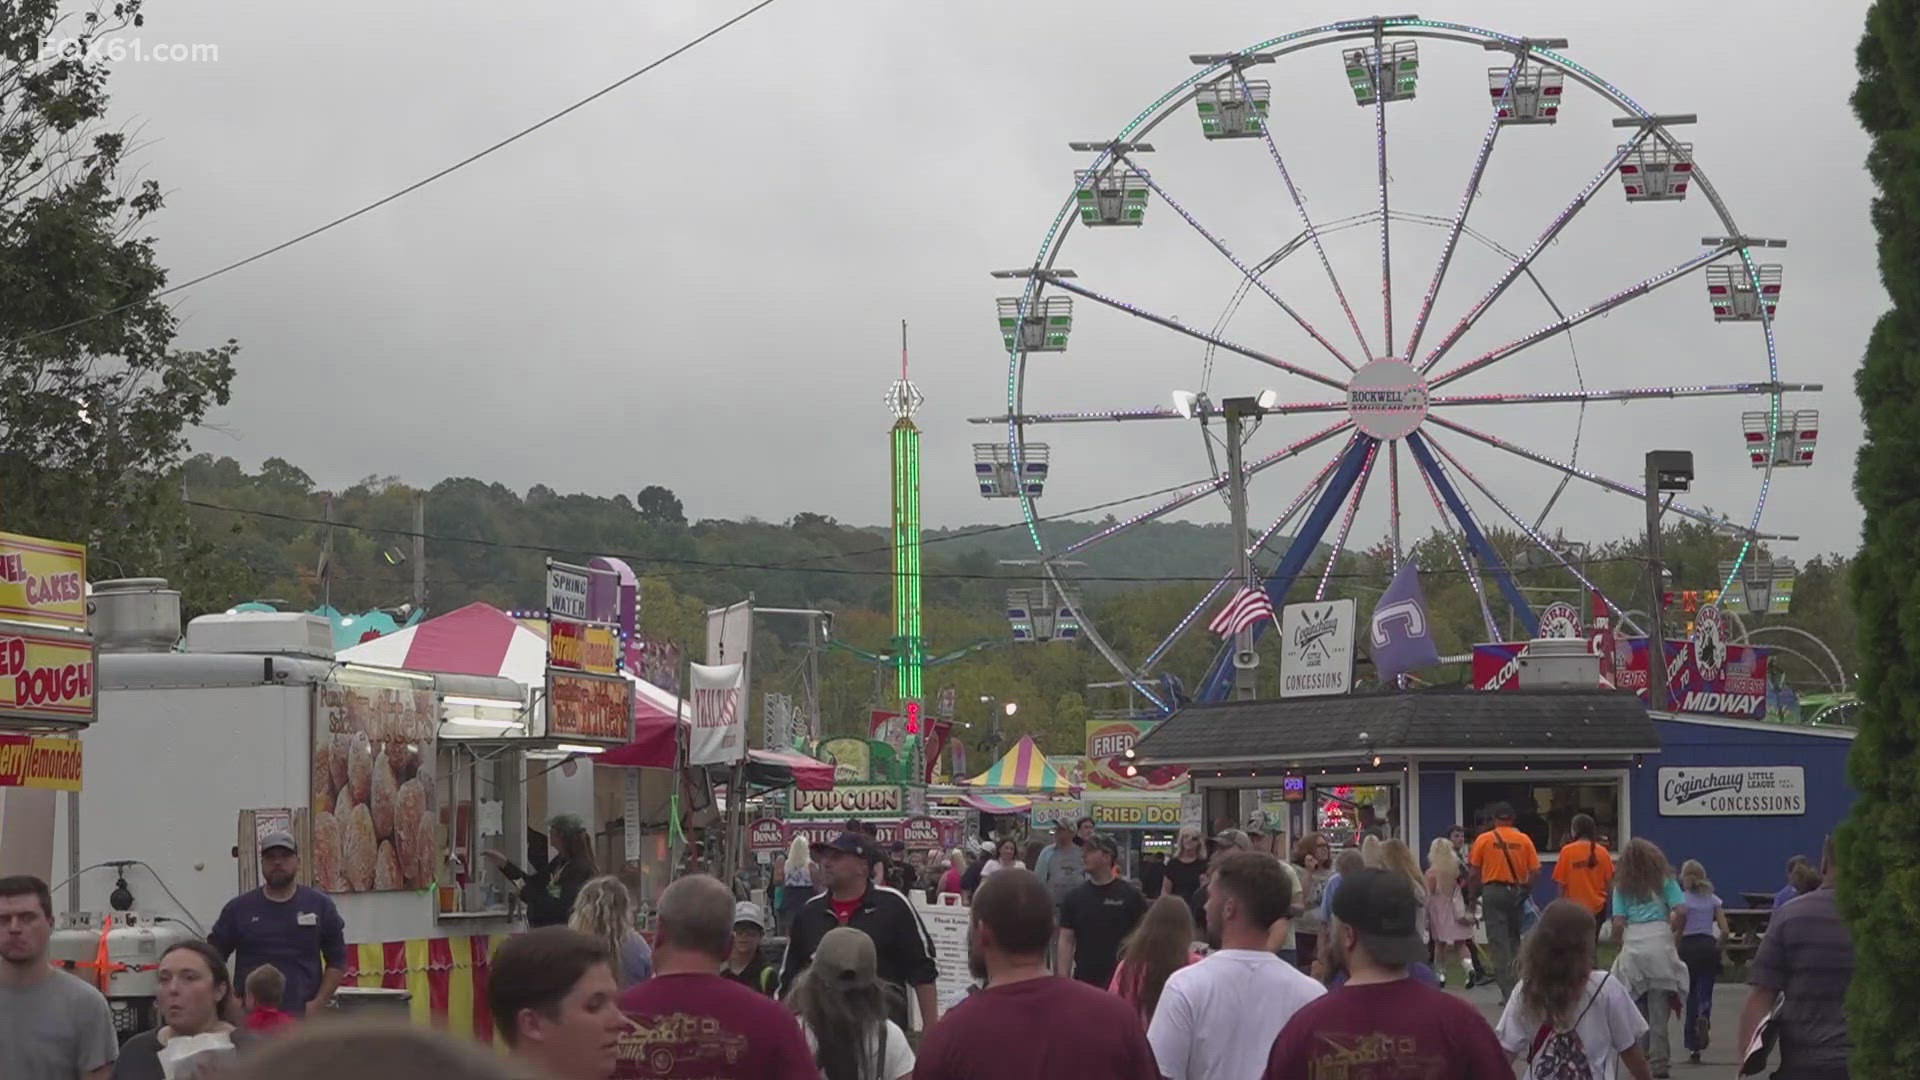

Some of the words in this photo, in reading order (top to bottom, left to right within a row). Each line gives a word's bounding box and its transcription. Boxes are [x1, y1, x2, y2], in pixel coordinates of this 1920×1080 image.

[1351, 391, 1404, 402] ROCKWELL
[26, 572, 81, 605] CAKES
[552, 573, 586, 595] SPRING
[1540, 606, 1583, 638] DURHAM
[1480, 644, 1529, 691] ELCOME
[16, 664, 92, 706] DOUGH
[1286, 671, 1342, 691] CONCESSIONS
[1683, 691, 1764, 714] MIDWAY
[1094, 735, 1135, 756] FRIED
[26, 738, 82, 782] lemonade
[1284, 777, 1303, 790] OPEN
[1747, 772, 1774, 780] LITTLE
[1664, 772, 1743, 803] Coginchaug
[794, 788, 897, 811] POPCORN
[1710, 796, 1801, 811] CONCESSIONS
[1092, 806, 1142, 822] FRIED
[1147, 806, 1182, 822] DOU
[759, 822, 777, 831] COLD
[904, 828, 939, 840] DRINKS
[911, 821, 931, 829] COLD
[753, 831, 782, 842] DRINKS
[791, 829, 840, 843] COTTO
